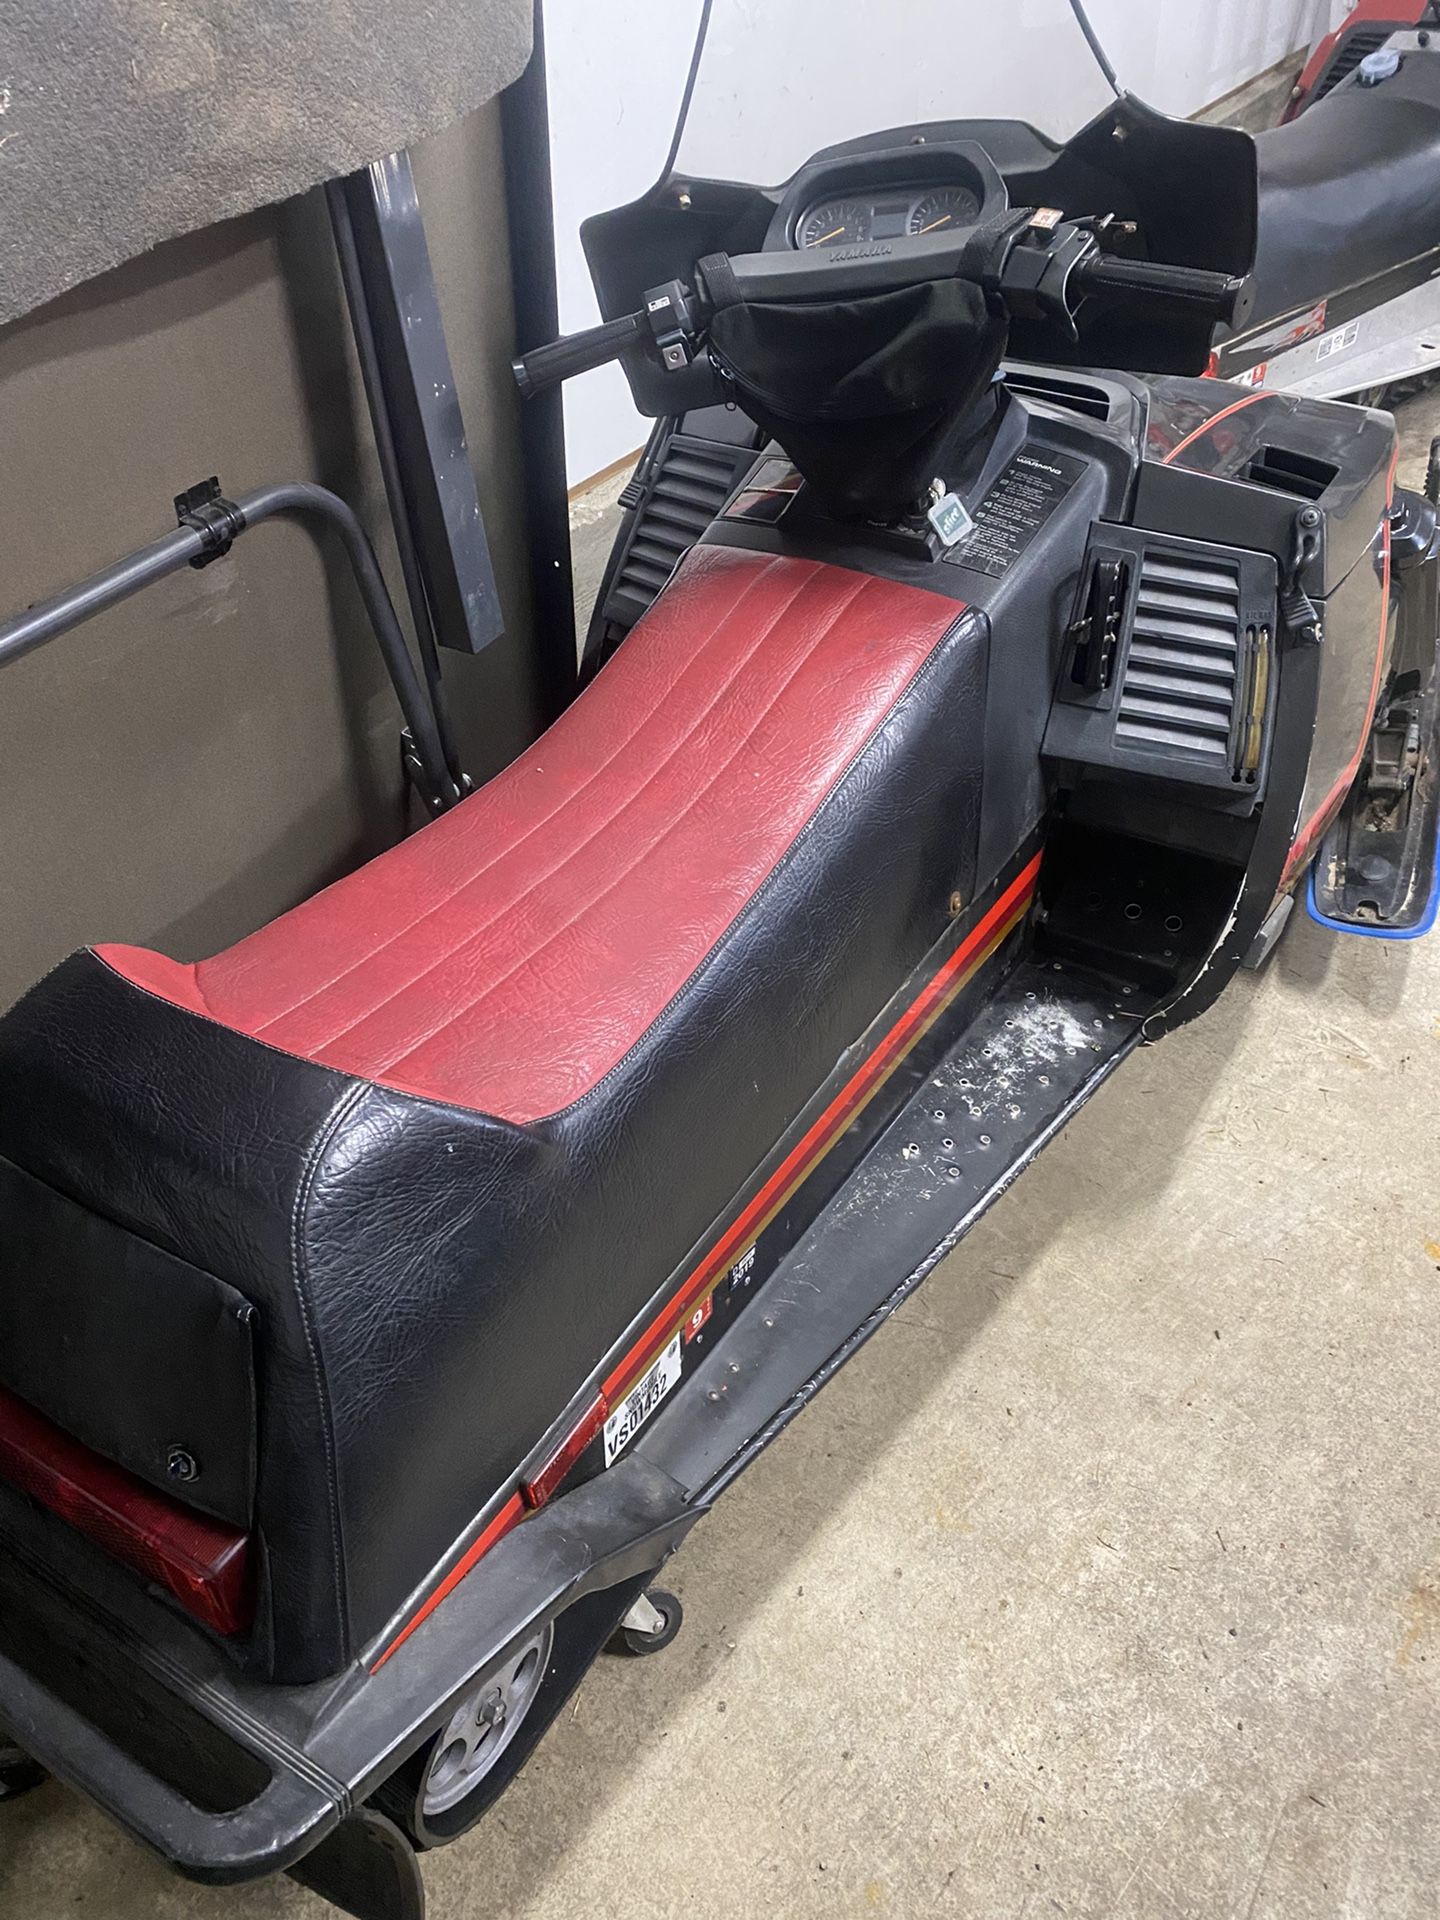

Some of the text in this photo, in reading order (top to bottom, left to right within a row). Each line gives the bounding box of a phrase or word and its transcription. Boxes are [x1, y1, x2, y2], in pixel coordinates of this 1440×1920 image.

[829, 244, 892, 262] YAMAHA
[1016, 457, 1062, 475] WARNING
[608, 1373, 667, 1457] VS01432
